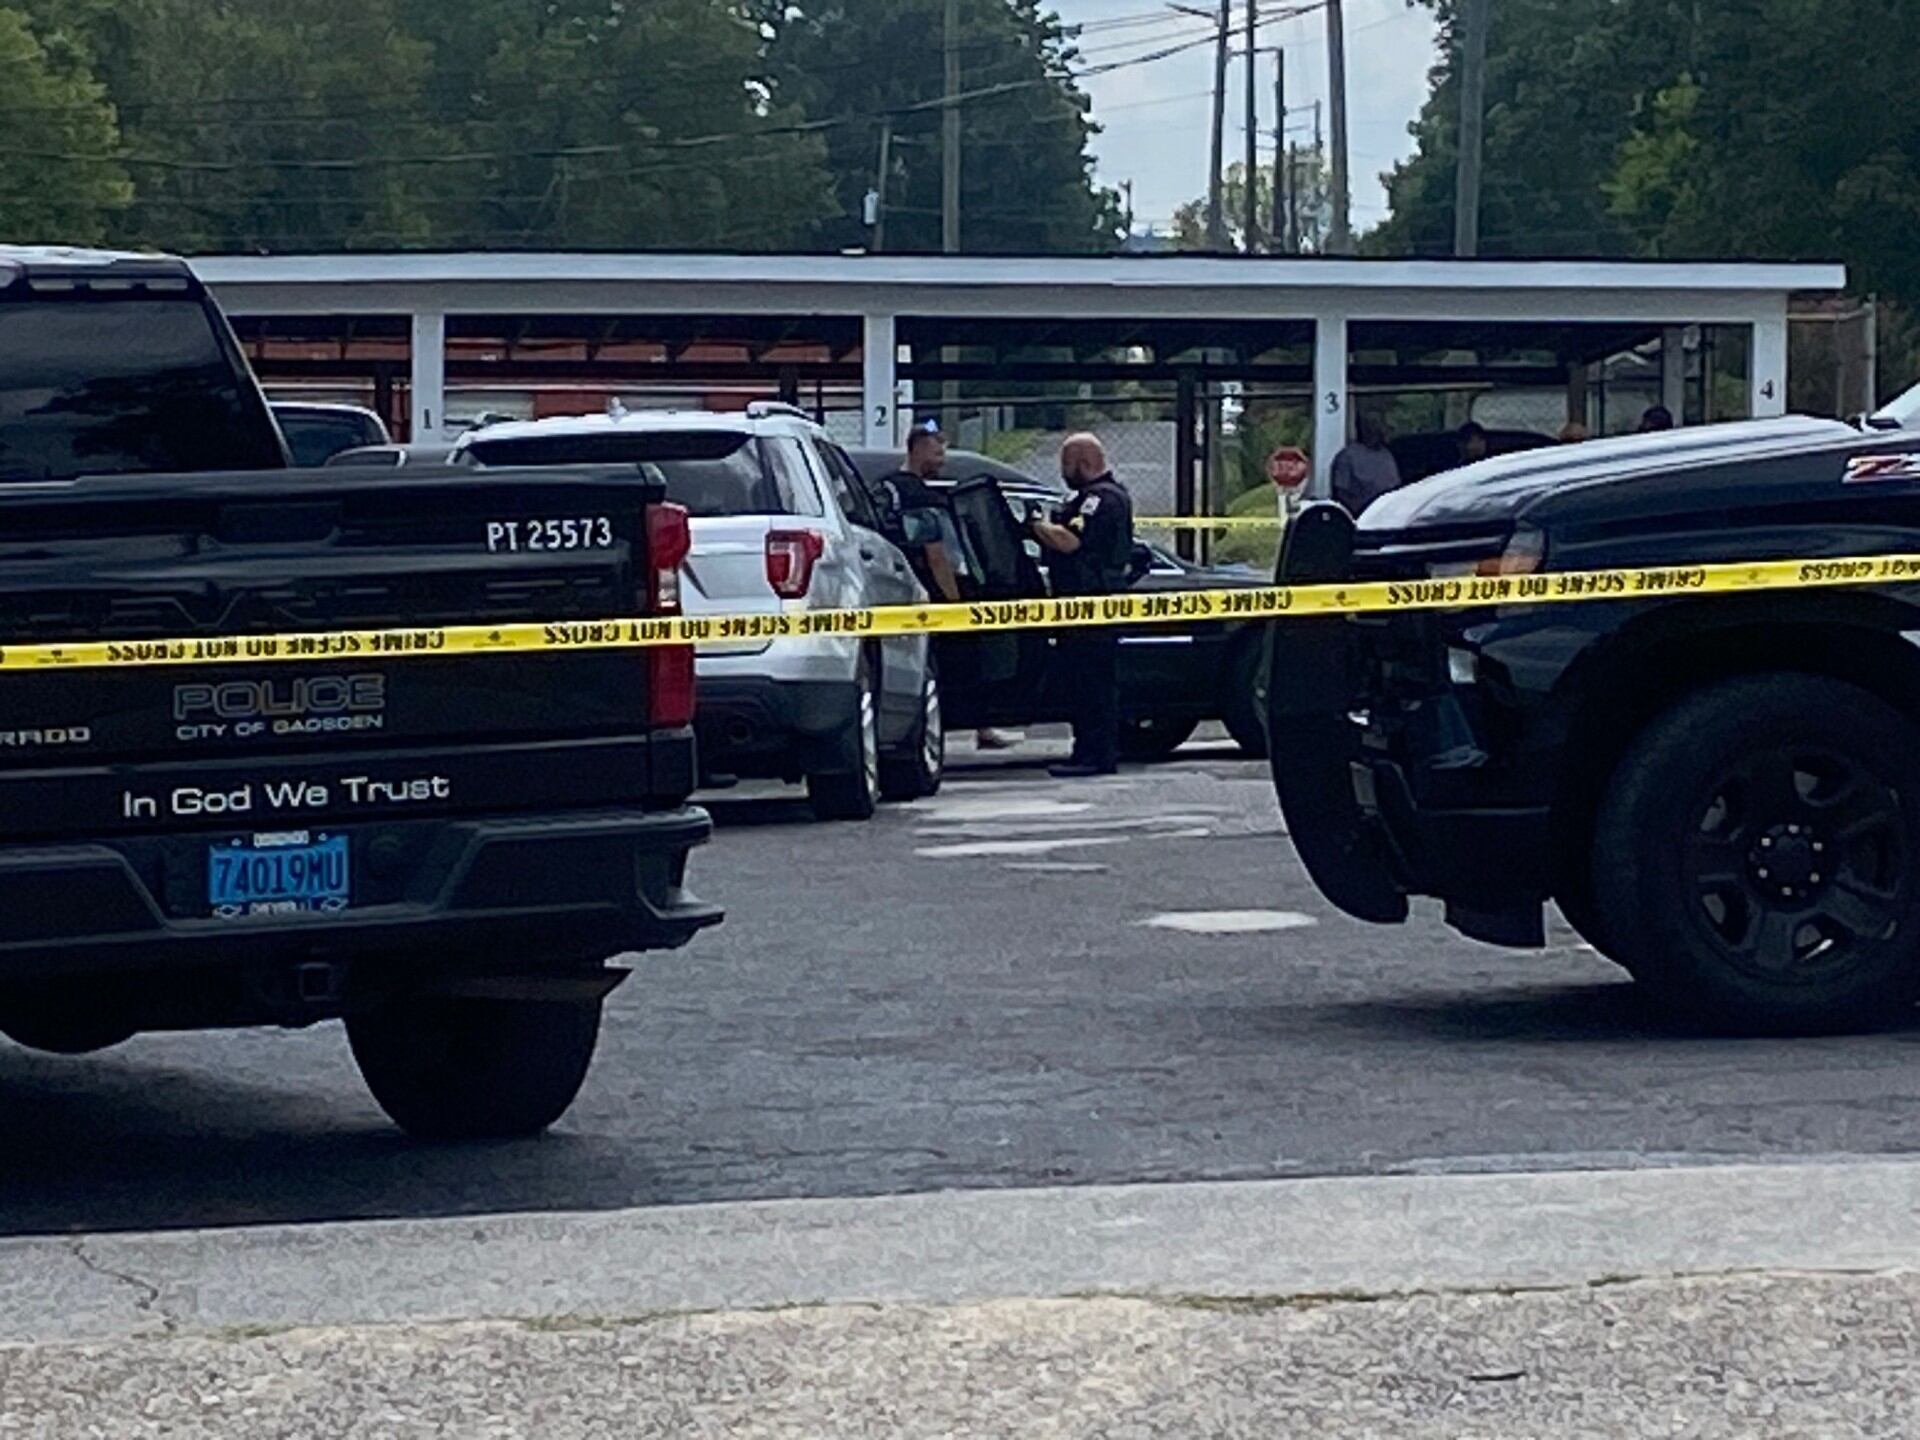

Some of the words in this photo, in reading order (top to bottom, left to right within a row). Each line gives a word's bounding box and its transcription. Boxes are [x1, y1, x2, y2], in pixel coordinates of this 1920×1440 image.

[1759, 379, 1775, 400] 4
[1324, 391, 1340, 415] 3
[423, 408, 432, 430] 1
[874, 405, 887, 427] 2
[487, 521, 518, 551] PT
[527, 517, 613, 549] 25573
[1467, 579, 1511, 599] NOT
[1517, 578, 1547, 597] DO
[1555, 571, 1625, 595] SCENE
[1633, 568, 1706, 590] CRIME
[1220, 591, 1293, 613] CRIME
[1387, 581, 1460, 605] CROSS
[969, 603, 1044, 625] CROSS
[1052, 599, 1096, 621] NOT
[1102, 598, 1132, 617] DO
[1141, 594, 1212, 617] SCENE
[628, 622, 671, 639] NOT
[680, 621, 709, 637] DO
[719, 615, 790, 636] SCENE
[799, 611, 873, 633] CRIME
[286, 635, 360, 654] SCENE
[370, 631, 445, 651] CRIME
[543, 626, 620, 644] CROSS
[107, 643, 185, 661] CROSS
[192, 641, 238, 659] NOT
[246, 639, 277, 656] DO
[173, 673, 386, 720] POLICE
[176, 724, 227, 740] CITY
[234, 721, 266, 737] OF
[273, 715, 383, 733] GADSDEN
[122, 790, 157, 818] In
[172, 784, 252, 814] God
[264, 781, 328, 808] We
[341, 775, 451, 803] Trust
[213, 850, 345, 898] 74019MU
